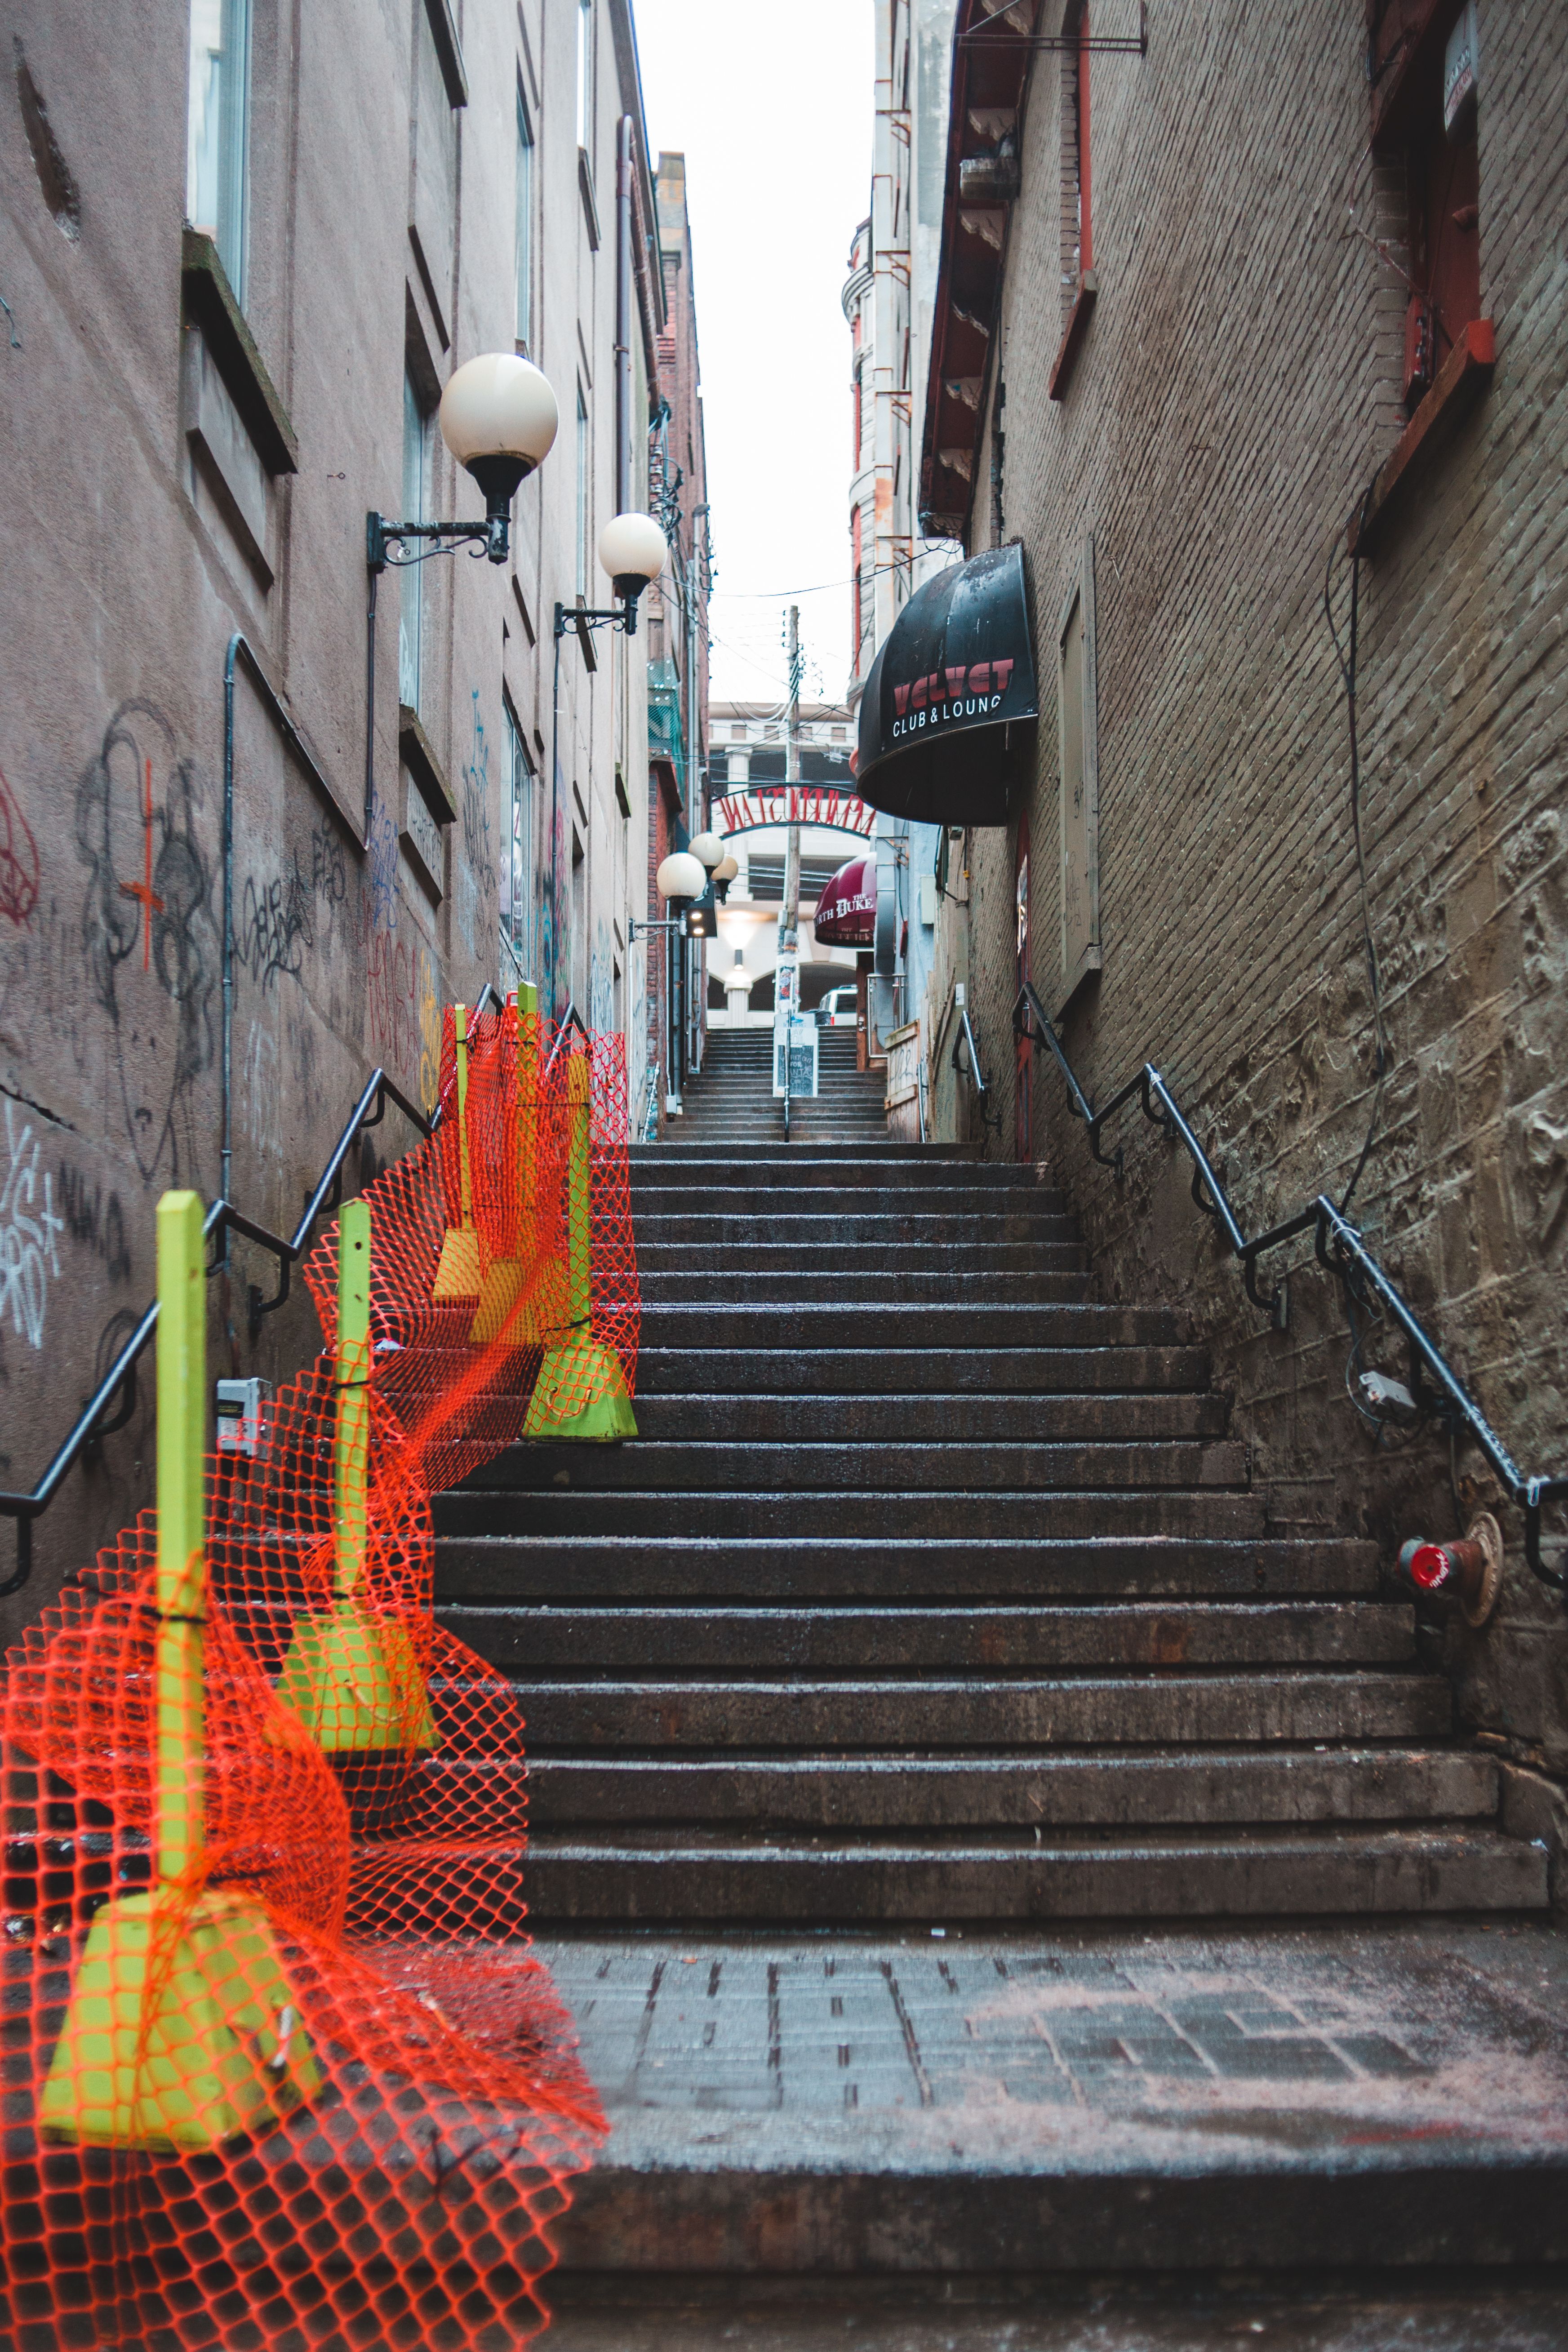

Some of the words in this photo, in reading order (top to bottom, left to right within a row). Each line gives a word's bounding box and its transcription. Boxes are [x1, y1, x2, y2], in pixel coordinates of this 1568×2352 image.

[894, 659, 1013, 716] VELVET
[893, 711, 926, 737] CLUB
[930, 707, 938, 723] &
[836, 898, 873, 919] DUKE
